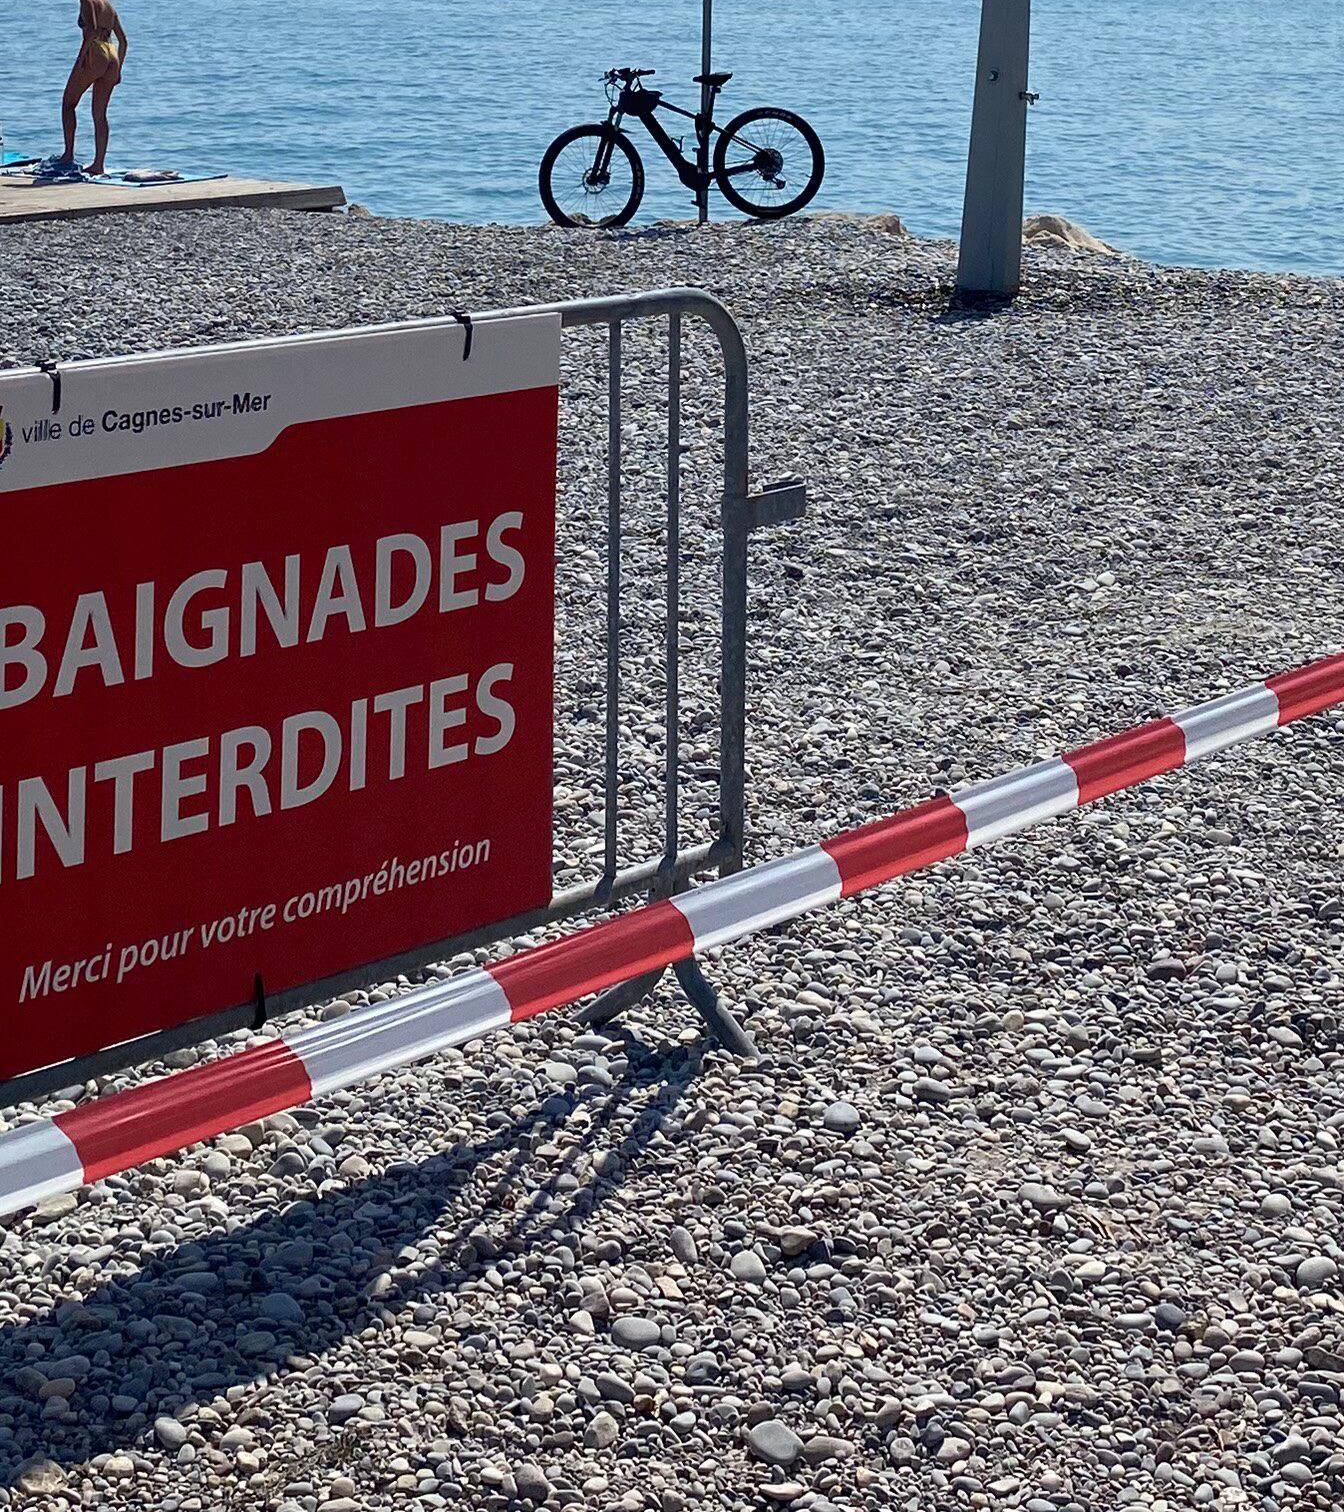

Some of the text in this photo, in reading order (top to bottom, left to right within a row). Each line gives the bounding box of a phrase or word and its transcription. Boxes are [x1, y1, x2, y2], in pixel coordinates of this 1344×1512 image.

[21, 391, 273, 444] ville de Cagnes-sur-Mer
[17, 838, 491, 1004] Merci pour votre compréhension
